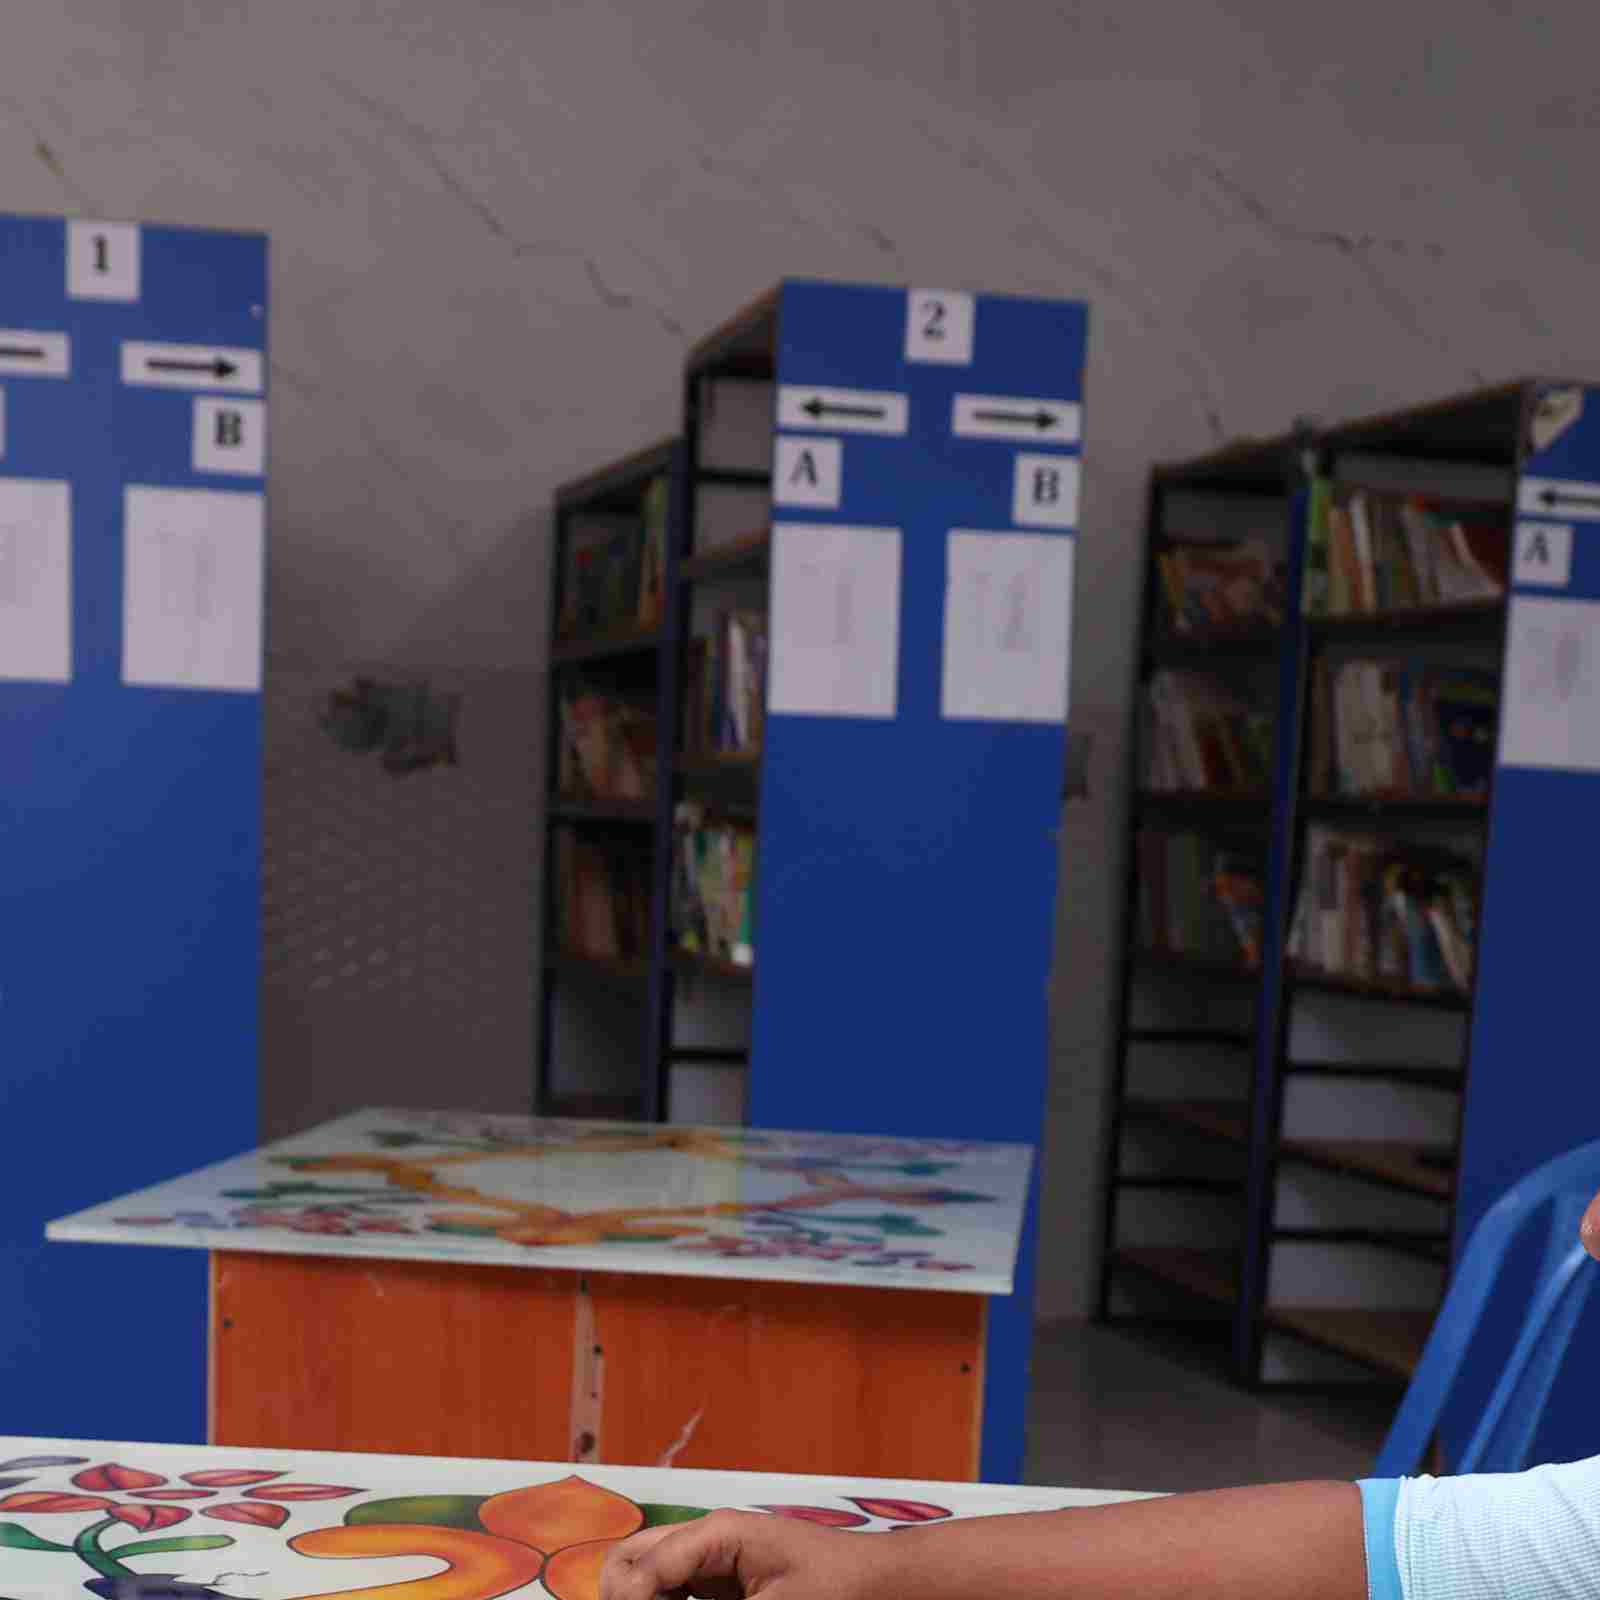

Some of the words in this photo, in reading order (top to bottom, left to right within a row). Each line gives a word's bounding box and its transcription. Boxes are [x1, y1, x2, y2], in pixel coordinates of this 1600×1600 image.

[92, 235, 110, 275] 1
[922, 301, 947, 341] 2
[213, 410, 244, 448] B
[790, 449, 820, 487] A
[1032, 467, 1061, 506] B
[1522, 530, 1551, 566] A
